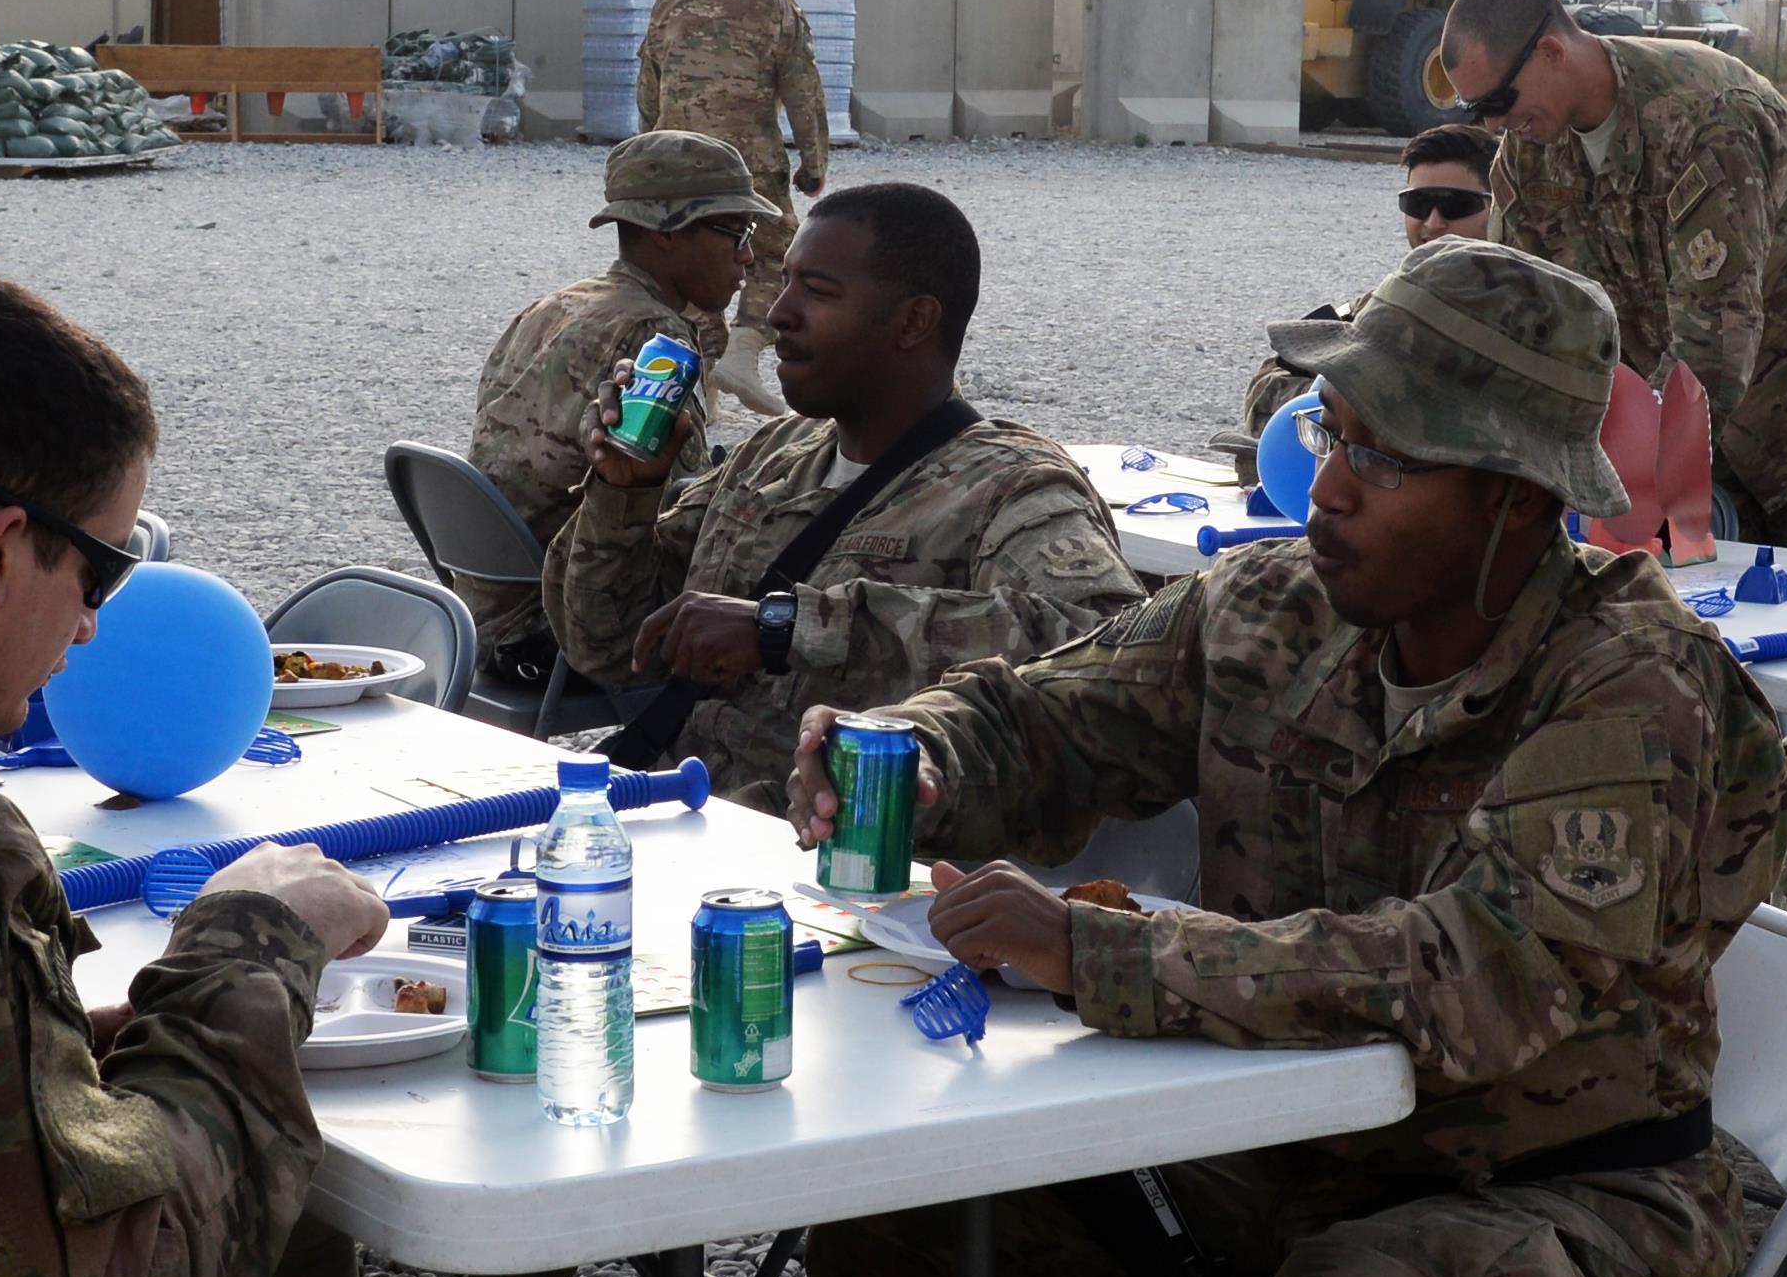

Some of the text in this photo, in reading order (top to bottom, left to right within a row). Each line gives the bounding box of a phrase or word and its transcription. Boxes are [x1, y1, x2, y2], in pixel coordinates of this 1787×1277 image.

[619, 375, 684, 403] prite
[862, 535, 905, 556] FORCE
[420, 933, 463, 946] PLASTIC
